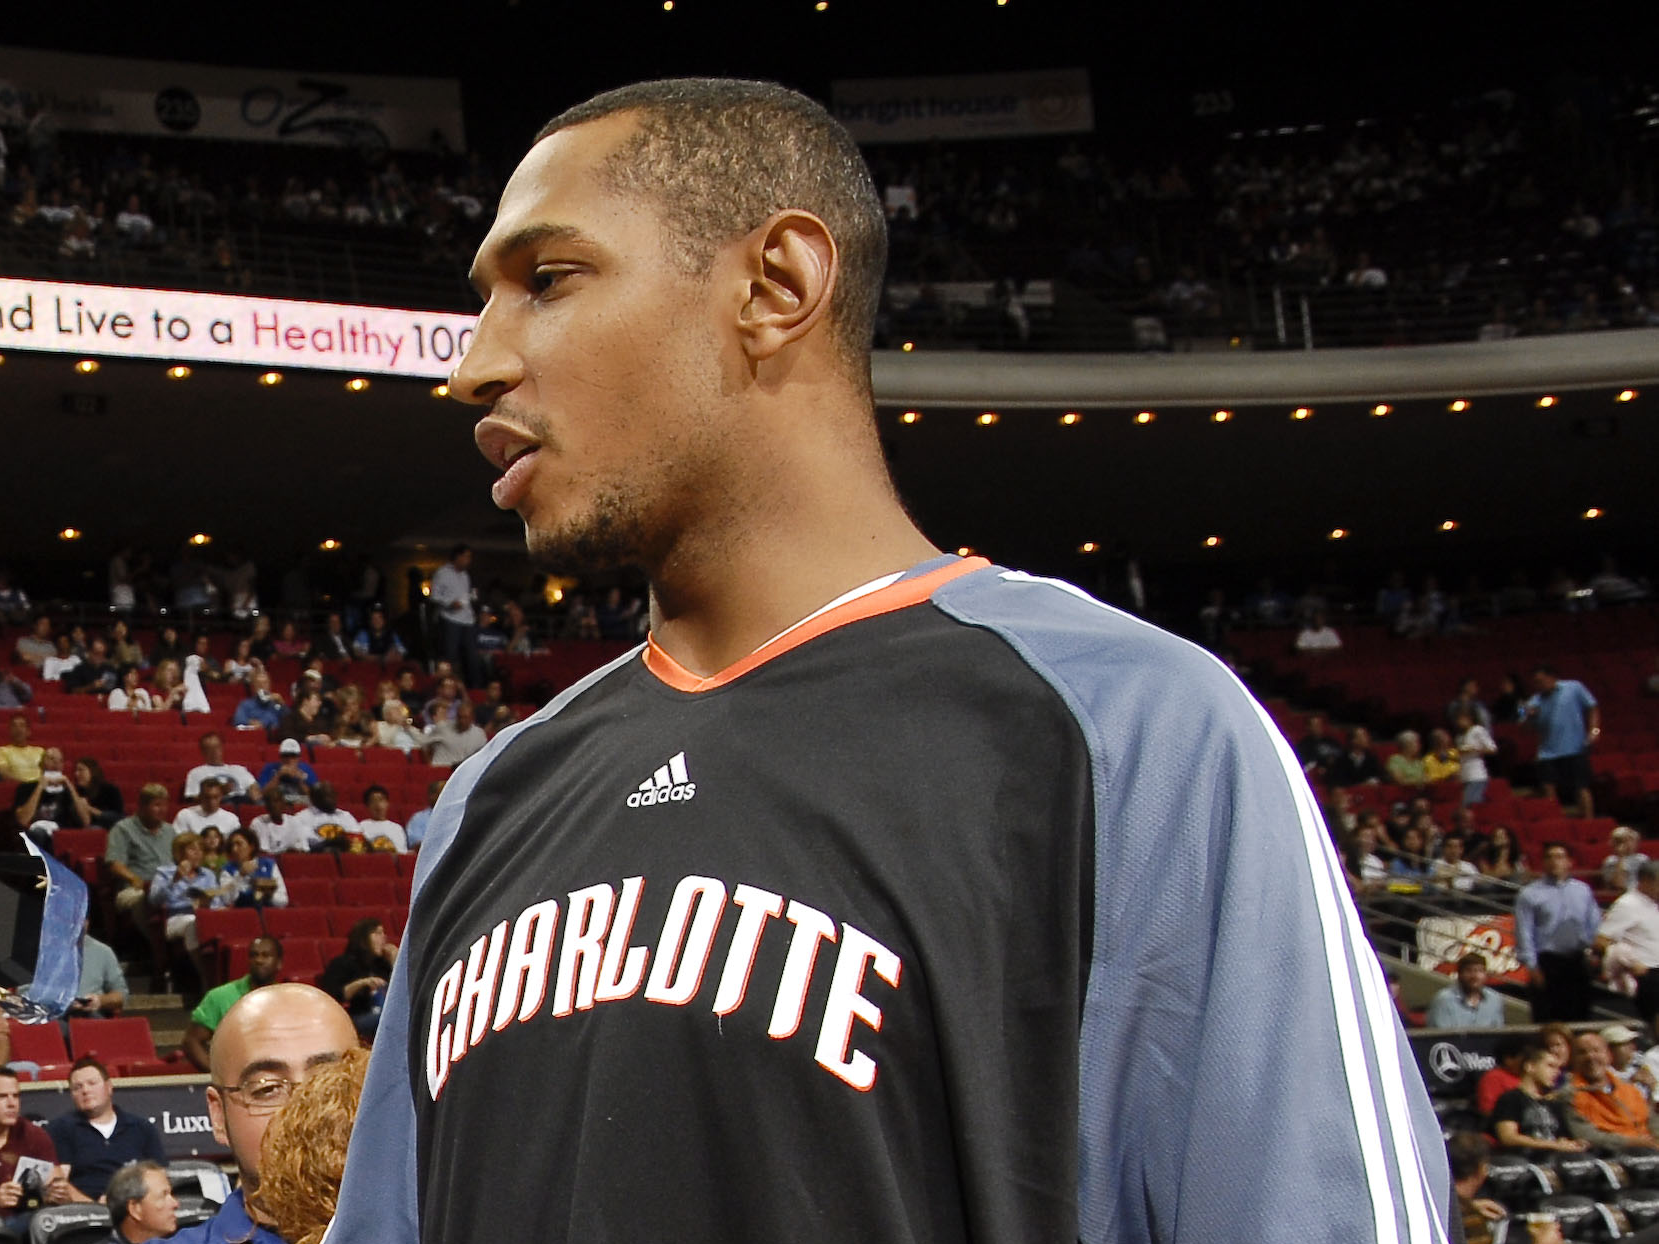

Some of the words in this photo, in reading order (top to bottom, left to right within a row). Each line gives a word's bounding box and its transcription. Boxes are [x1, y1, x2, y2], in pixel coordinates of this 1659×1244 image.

[55, 294, 134, 339] Live
[153, 307, 191, 343] to
[209, 318, 233, 345] a
[252, 310, 404, 367] Healthy
[626, 781, 696, 808] adidas
[426, 873, 902, 1102] CHARLOTTE
[162, 1110, 215, 1134] Luxu
